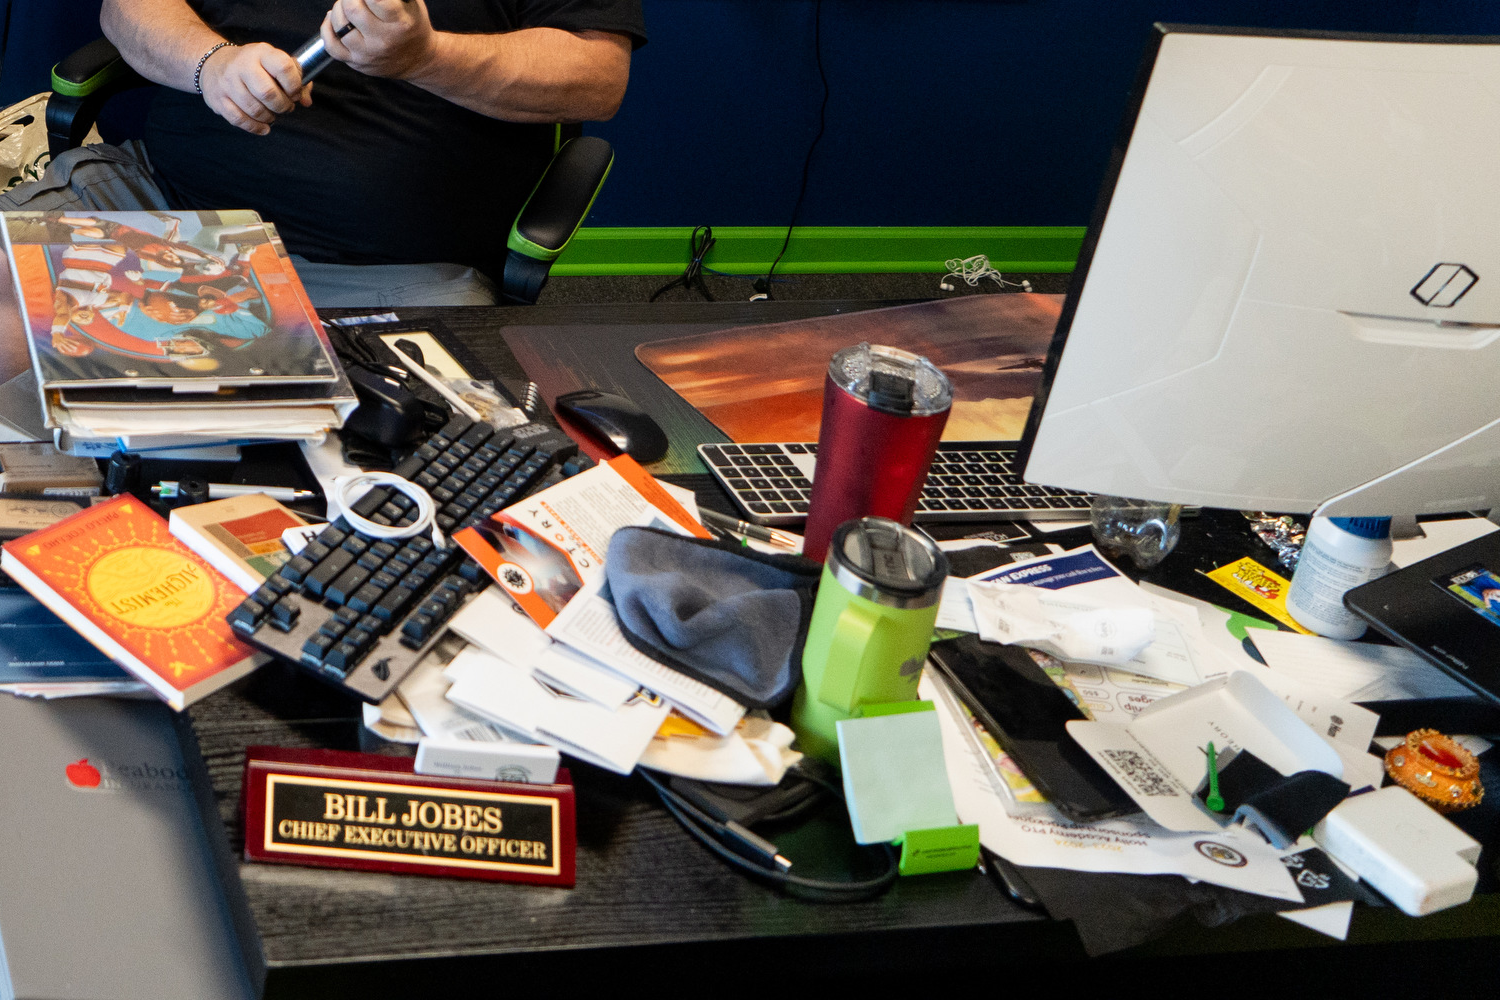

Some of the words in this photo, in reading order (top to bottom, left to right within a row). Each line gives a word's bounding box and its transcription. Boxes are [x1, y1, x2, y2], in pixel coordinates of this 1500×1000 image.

[110, 562, 199, 615] ALCHEMIST
[1009, 564, 1052, 581] EXPRESS
[323, 792, 396, 825] BILL
[402, 799, 503, 834] JOBES
[278, 819, 341, 842] CHIEF
[344, 824, 457, 852] EXECUTIVE
[460, 835, 548, 861] OFFICER
